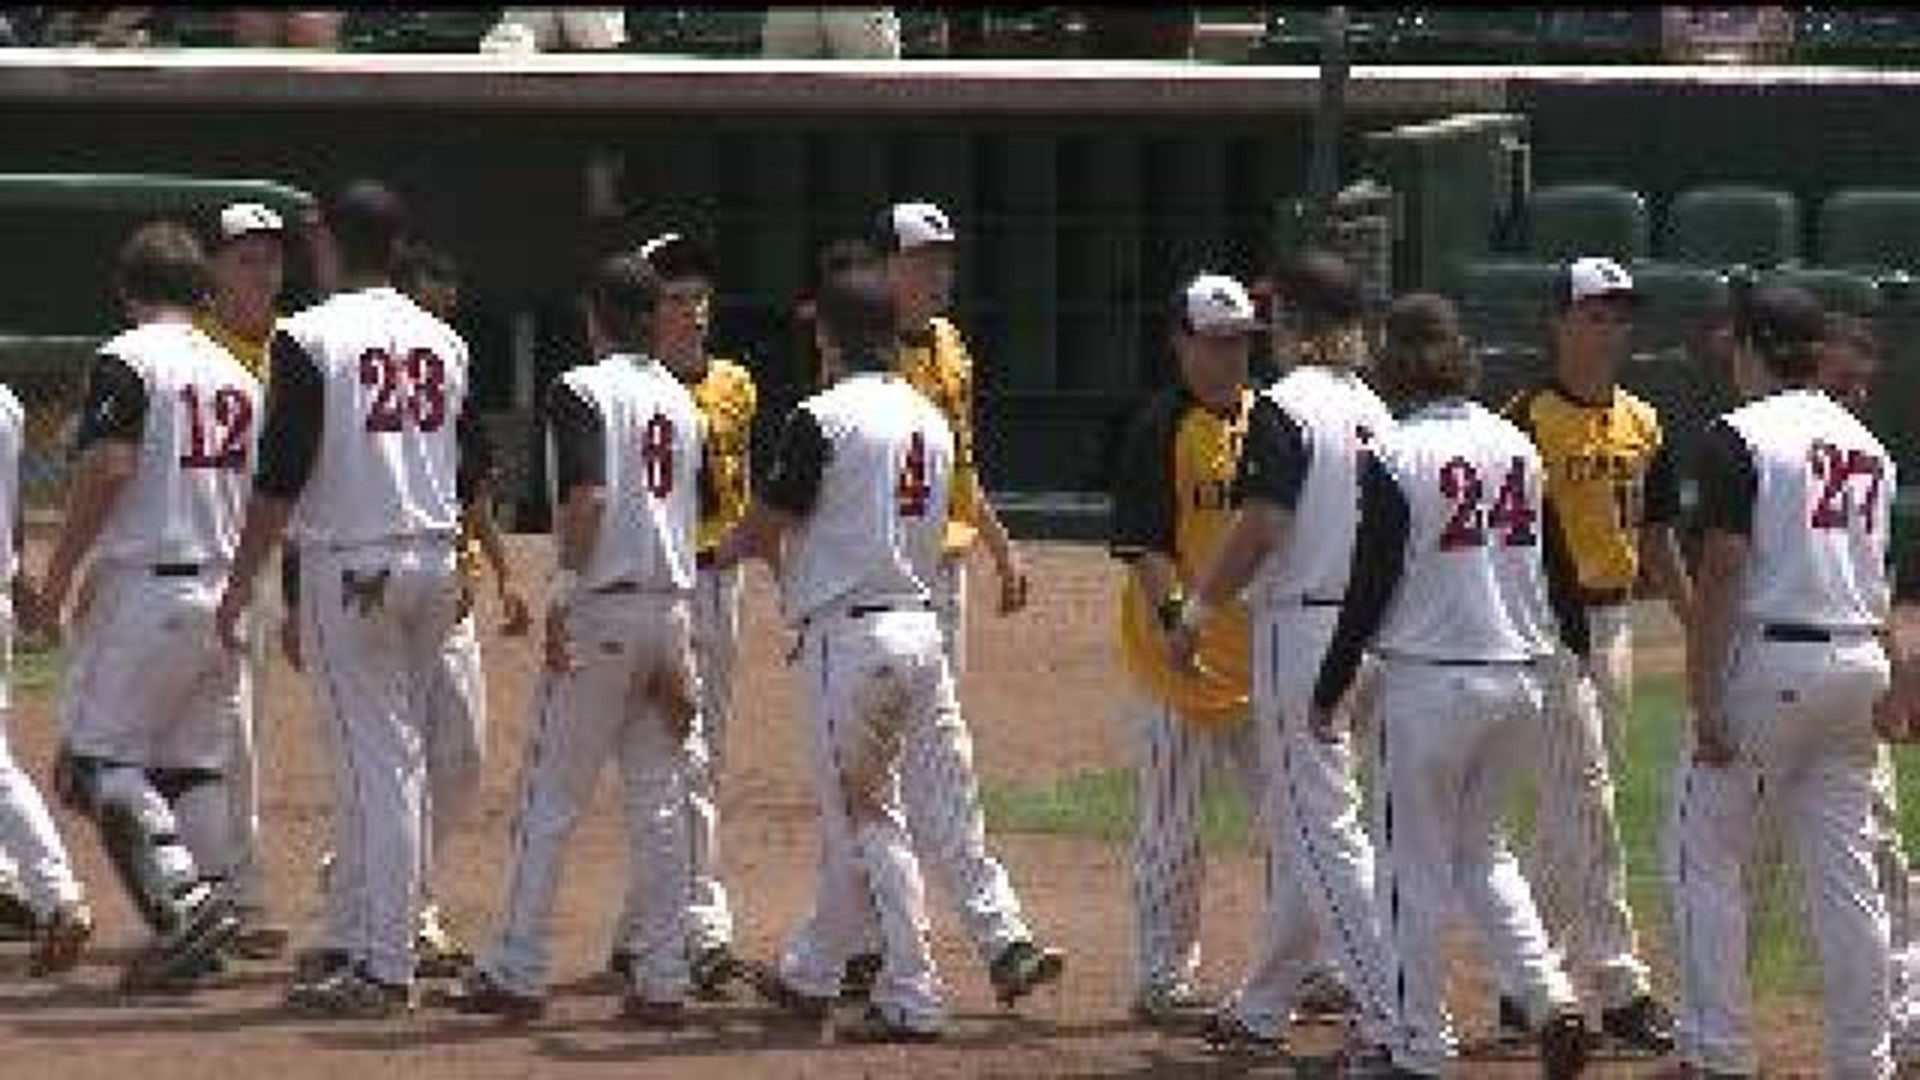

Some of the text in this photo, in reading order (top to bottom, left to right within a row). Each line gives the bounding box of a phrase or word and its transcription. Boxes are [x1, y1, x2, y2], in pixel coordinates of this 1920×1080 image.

[179, 384, 252, 472] 12
[898, 430, 931, 518] 4
[1439, 455, 1537, 550] 24
[1806, 438, 1884, 534] 27
